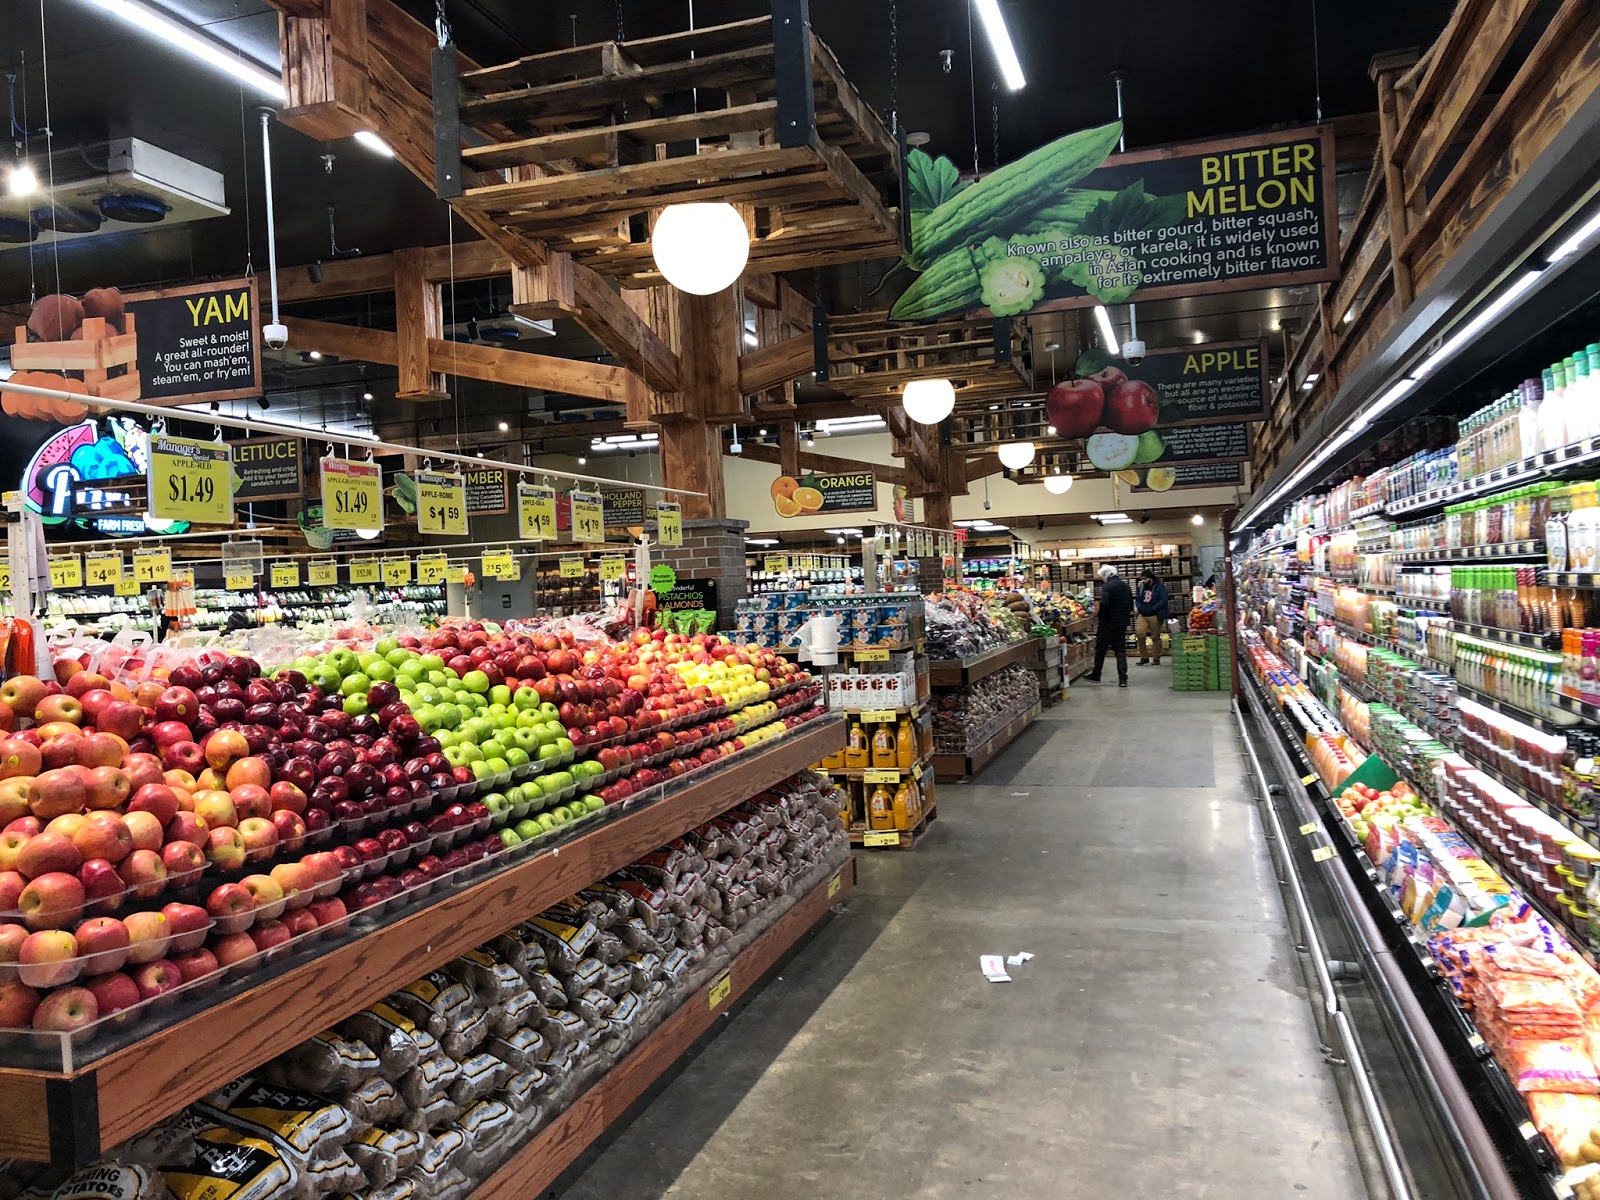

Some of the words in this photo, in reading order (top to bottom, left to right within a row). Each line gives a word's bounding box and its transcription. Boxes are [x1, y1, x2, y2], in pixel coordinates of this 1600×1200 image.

[1201, 143, 1316, 186] BITTER
[1186, 174, 1315, 219] MELON
[1007, 241, 1056, 257] Known
[1060, 236, 1090, 251] also
[1094, 235, 1110, 246] as
[1114, 229, 1153, 244] bitter
[1157, 221, 1208, 240] gourd,
[1212, 216, 1253, 232] bitter
[1258, 207, 1319, 228] squash,
[1041, 248, 1116, 268] ampalaya,
[1120, 245, 1137, 257] or
[1141, 238, 1193, 256] karela,
[1196, 235, 1207, 248] it
[1210, 234, 1222, 247] is
[1225, 228, 1276, 245] widely
[1280, 221, 1319, 238] used
[1089, 263, 1103, 276] in
[1107, 259, 1146, 274] Asian
[1151, 251, 1212, 269] cooking
[1216, 245, 1246, 261] and
[1250, 244, 1262, 257] is
[1266, 239, 1320, 255] known
[1098, 275, 1119, 289] for
[1122, 272, 1139, 287] its
[1143, 264, 1221, 284] extremely
[1225, 259, 1267, 275] bitter
[1271, 254, 1321, 270] flavor.
[186, 292, 249, 327] YAM
[179, 335, 208, 348] Sweet
[210, 334, 218, 344] &
[220, 330, 249, 343] moist!
[154, 352, 162, 362] A
[163, 349, 189, 363] great
[191, 341, 250, 358] all-rounder!
[163, 362, 181, 373] You
[183, 361, 201, 371] can
[1182, 348, 1259, 375] APPLE
[203, 371, 214, 380] or
[1157, 382, 1181, 391] There
[1183, 381, 1197, 389] are
[1199, 379, 1222, 388] many
[1224, 375, 1259, 385] varieties
[1164, 390, 1179, 398] but
[1180, 388, 1191, 396] all
[1192, 388, 1206, 396] are
[1208, 386, 1219, 394] an
[1221, 383, 1260, 393] excellent
[1177, 396, 1206, 405] source
[1207, 394, 1217, 402] of
[1218, 392, 1248, 401] vitamin
[1188, 403, 1207, 412] fiber
[1218, 399, 1260, 410] potassium
[157, 438, 201, 456] Manager's
[233, 441, 296, 463] LETTUCE
[172, 459, 212, 470] APPLE-RED
[169, 474, 214, 503] $1.49
[820, 474, 872, 489] ORANGE
[335, 489, 368, 514] $1.49
[603, 491, 642, 501] HOLLAND
[612, 499, 642, 508] PEPPER
[98, 518, 121, 531] FARM
[122, 519, 145, 532] FRESH
[658, 591, 704, 601] PISTACHIOS
[672, 584, 695, 592] onderful
[664, 600, 704, 609] ALMONDS
